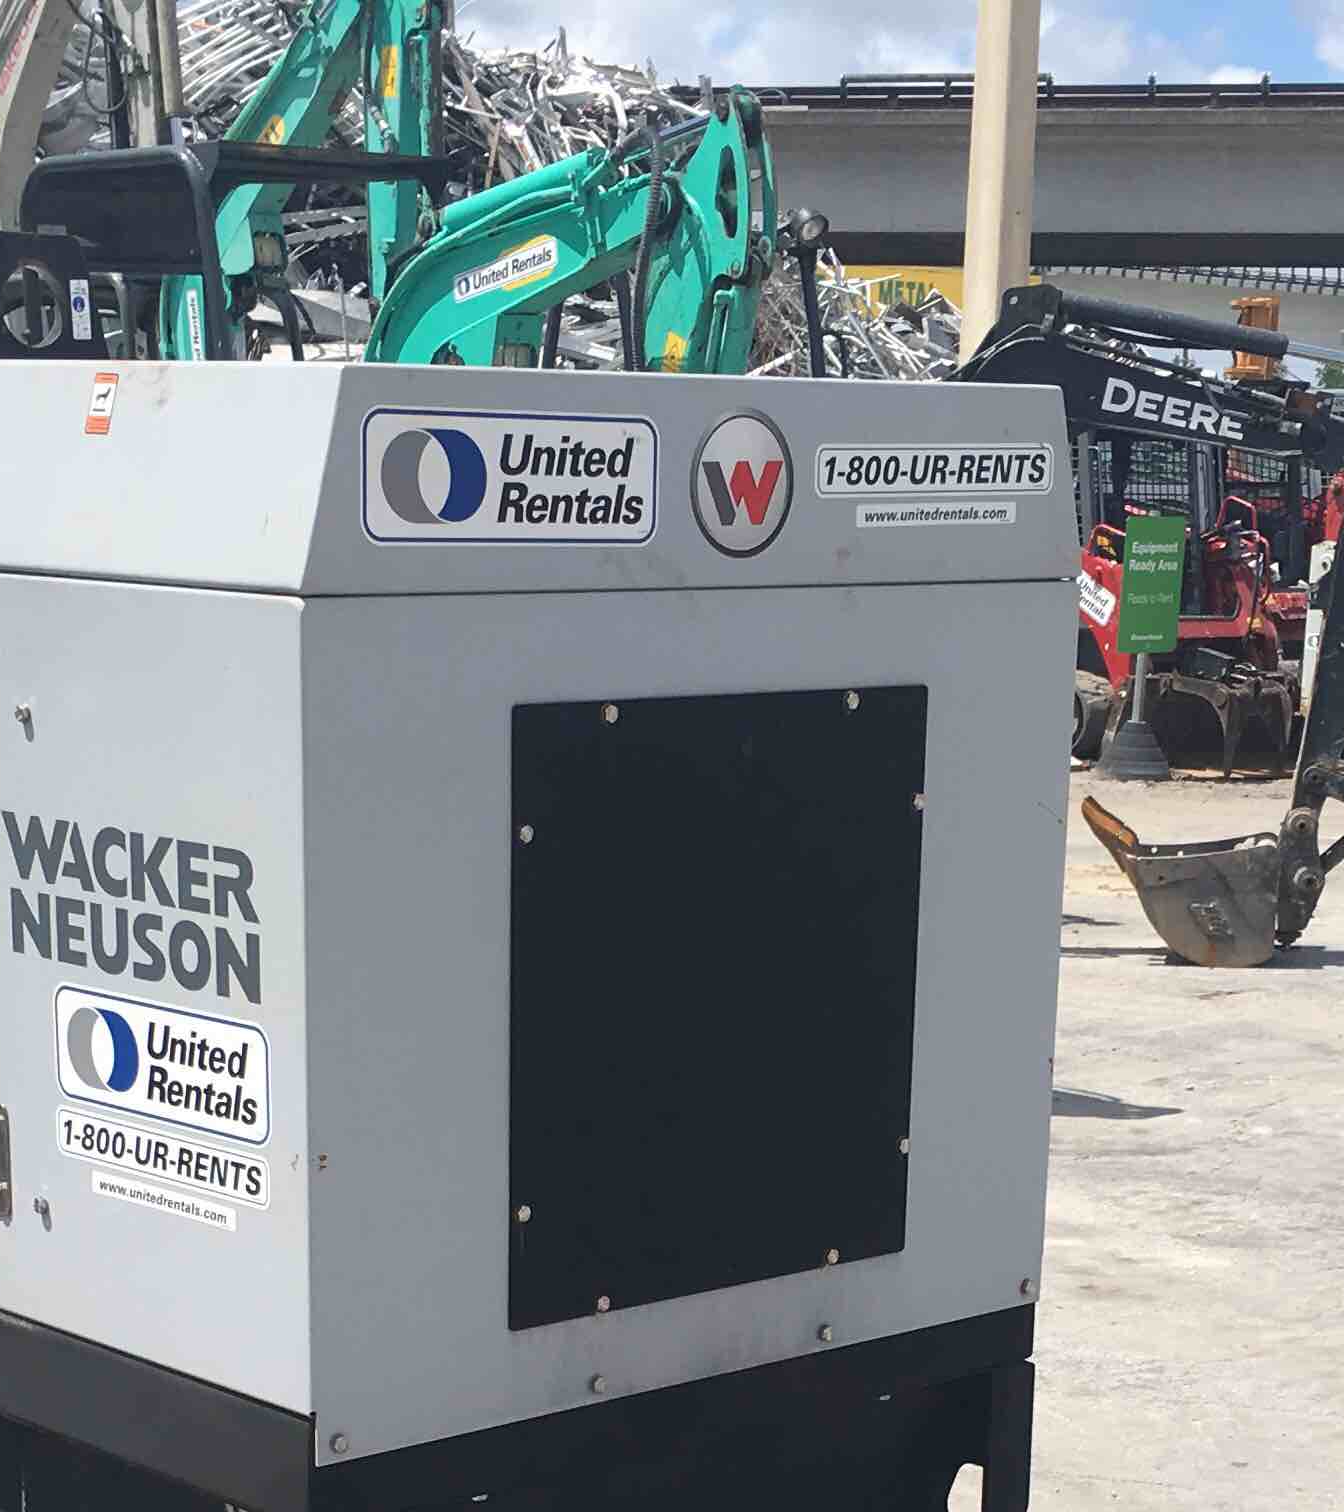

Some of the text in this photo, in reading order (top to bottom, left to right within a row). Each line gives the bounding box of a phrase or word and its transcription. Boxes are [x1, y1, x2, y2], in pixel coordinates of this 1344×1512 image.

[472, 248, 553, 290] United Rentals
[1100, 376, 1245, 441] DEERE
[499, 434, 635, 478] United
[824, 453, 1048, 487] 1-800-UR-RENTS
[497, 482, 644, 525] Rentals
[864, 508, 1008, 523] www.unitedrentals.com
[1128, 559, 1179, 574] Ready Area
[1131, 541, 1179, 556] Equipment
[1079, 594, 1106, 620] entals
[0, 810, 262, 925] WACKER
[9, 886, 262, 1006] NEUSON
[146, 1021, 249, 1080] United
[146, 1064, 259, 1126] Rentals
[64, 1119, 262, 1197] 1-800-UR-RENTS
[99, 1180, 228, 1225] www.unitedrentals.com
